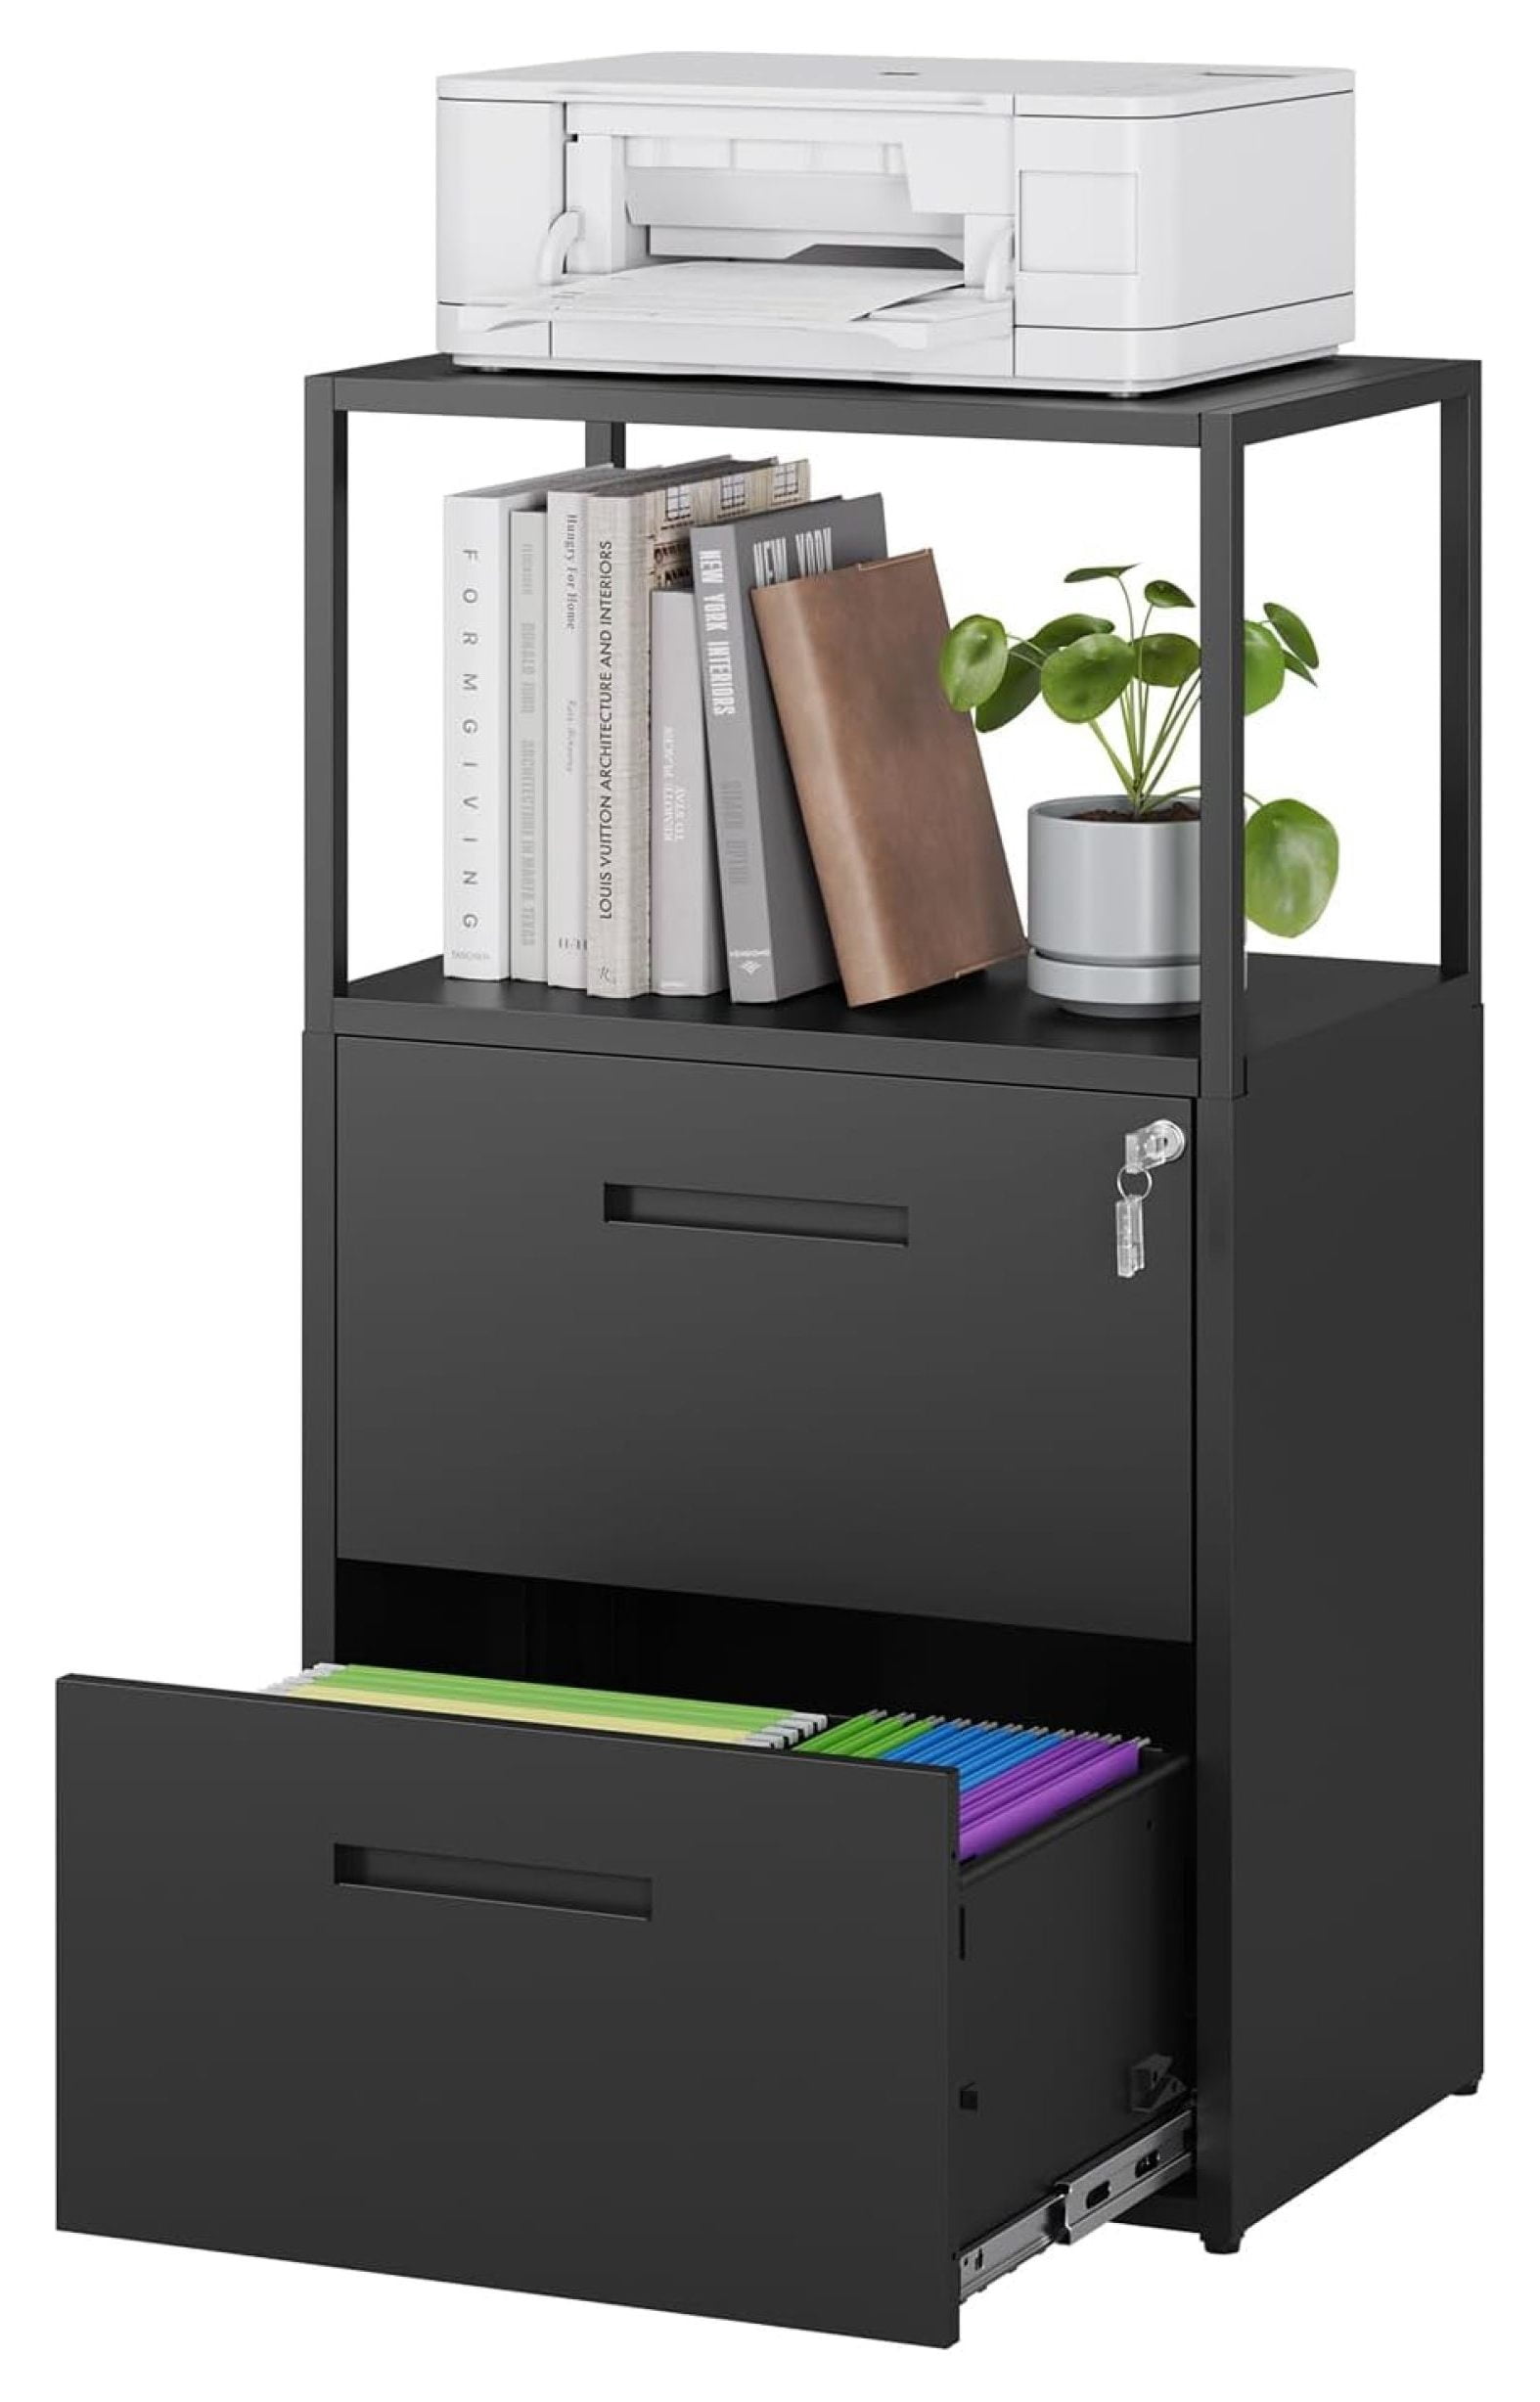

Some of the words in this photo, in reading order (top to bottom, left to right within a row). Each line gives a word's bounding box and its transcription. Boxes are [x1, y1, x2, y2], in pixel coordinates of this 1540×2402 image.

[599, 540, 612, 625] INTERIORS
[699, 550, 723, 583] NEW
[753, 536, 788, 588] NEW
[703, 593, 728, 631] YORK
[599, 630, 612, 667] AND
[707, 641, 735, 716] INTERIORS
[599, 672, 612, 791] ARCHITECTURE
[599, 795, 612, 867] VUITTON
[599, 872, 612, 919] LOUIS
